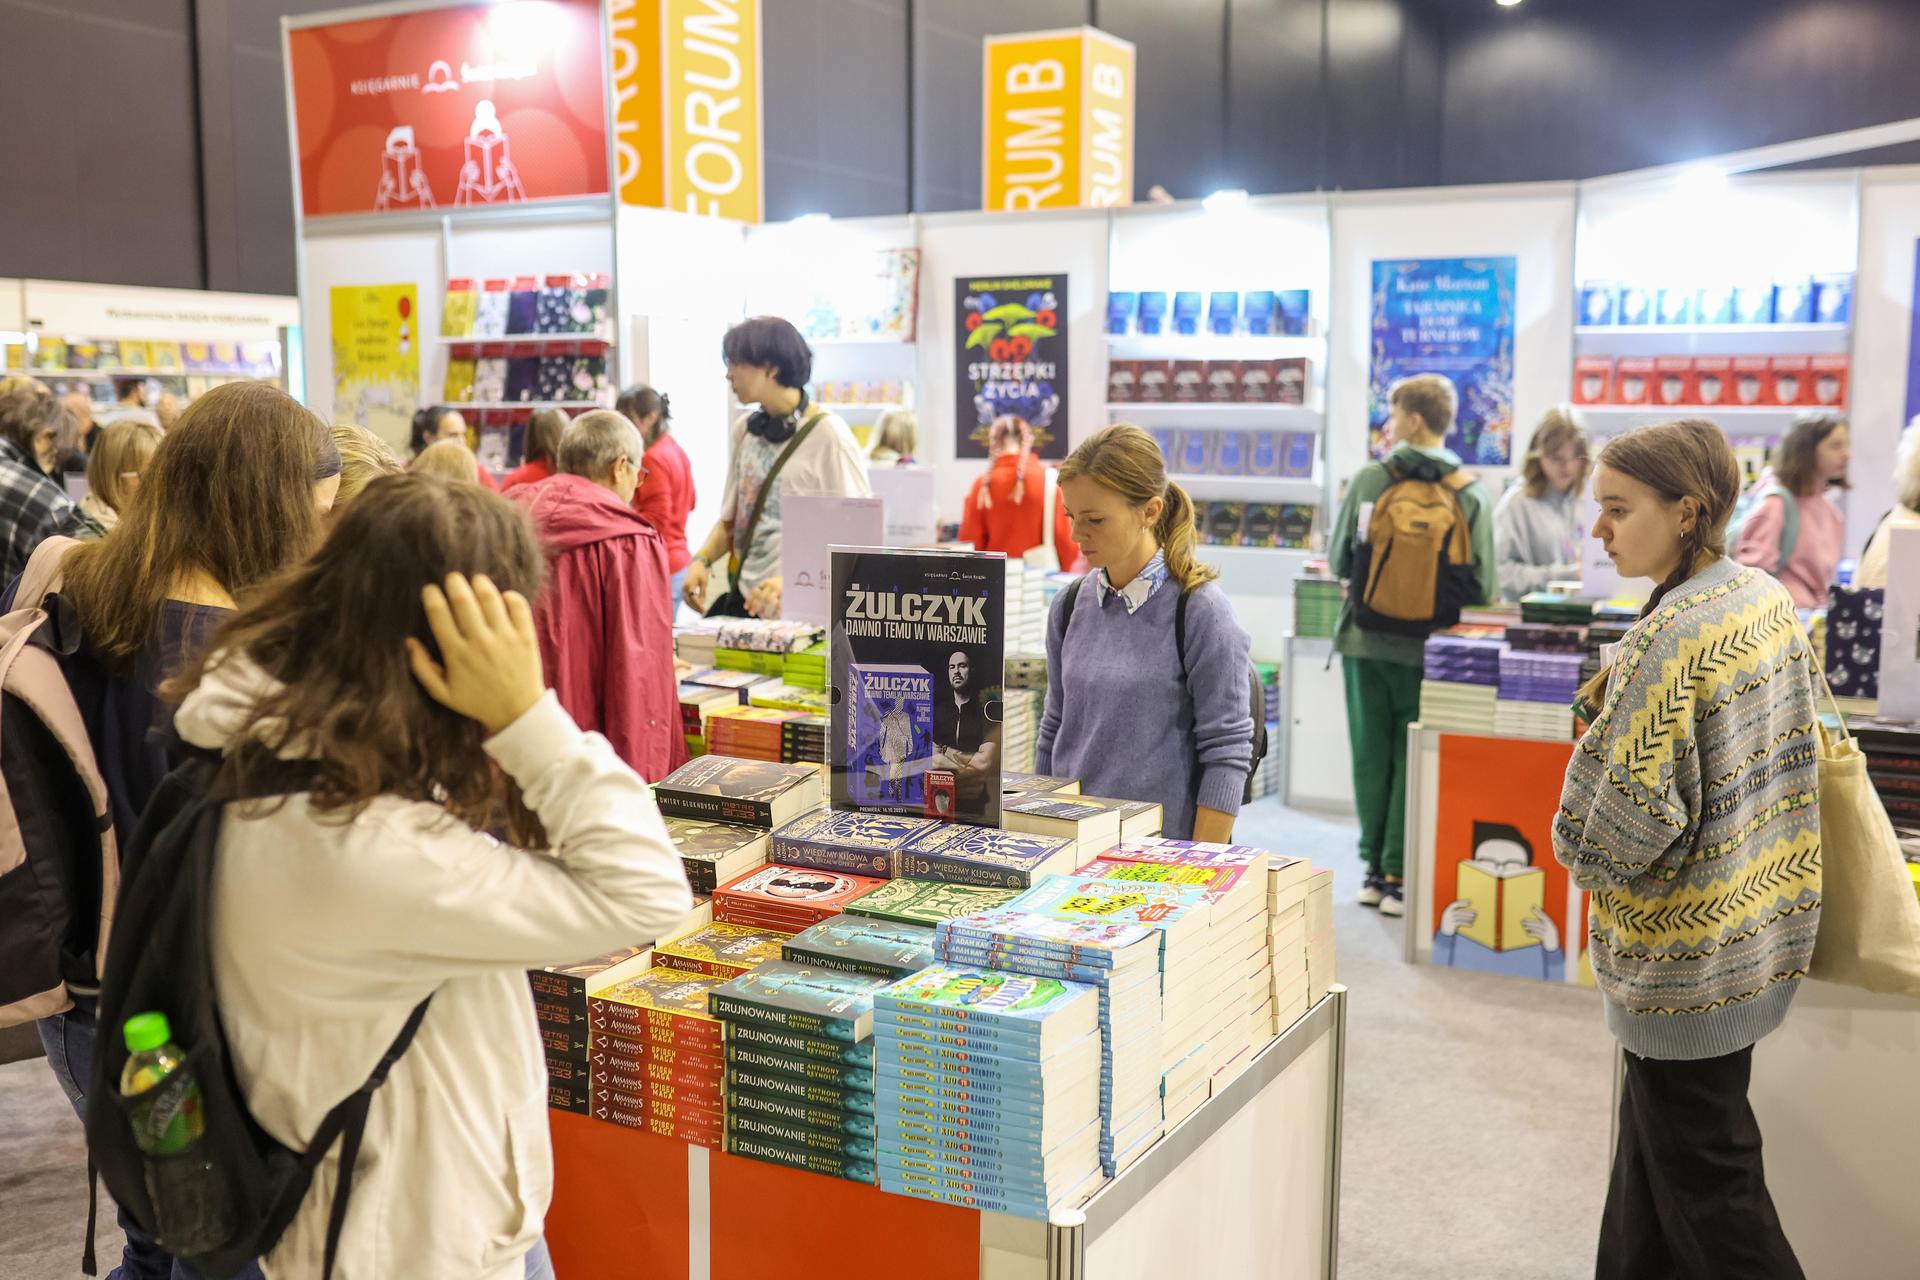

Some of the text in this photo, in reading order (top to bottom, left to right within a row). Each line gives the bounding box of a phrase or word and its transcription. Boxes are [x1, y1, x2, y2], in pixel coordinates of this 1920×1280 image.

[1005, 59, 1065, 94] B
[1092, 63, 1124, 98] B
[845, 583, 987, 626] ŻULCZYK
[846, 619, 987, 645] DAWNO TEMU W WARSZAWIE
[864, 672, 930, 692] ŻULCZYK
[659, 797, 719, 811] DMITRY GLUKHOVSKY
[933, 862, 1002, 881] WIEDŹMY KIJOWA
[792, 953, 890, 975] ZRUJNOWANIE ANTHONY
[647, 1010, 673, 1022] SPISEK
[719, 1001, 787, 1025] ZRUJNOWANIE
[788, 1015, 821, 1027] ANTHONY
[650, 1025, 675, 1038] SPISEK
[737, 1027, 805, 1050] ZRUJNOWANIE
[651, 1045, 677, 1058] SPISEK
[806, 1040, 840, 1052] ANTHONY
[737, 1050, 805, 1073] ZRUJNOWANIE
[648, 1063, 673, 1076] SPISEK
[807, 1063, 840, 1075] ANTHONY
[650, 1081, 676, 1094] SPISEK
[738, 1073, 806, 1096] ZRUJNOWANIE
[807, 1086, 841, 1098] ANTHONY
[651, 1100, 676, 1113] SPISEK
[738, 1096, 806, 1119] ZRUJNOWANIE
[807, 1109, 841, 1121] ANTHONY
[650, 1118, 675, 1131] SPISEK
[738, 1119, 806, 1142] ZRUJNOWANIE
[808, 1132, 841, 1144] ANTHONY
[739, 1141, 807, 1165] ZRUJNOWANIE
[808, 1155, 841, 1167] ANTHONY
